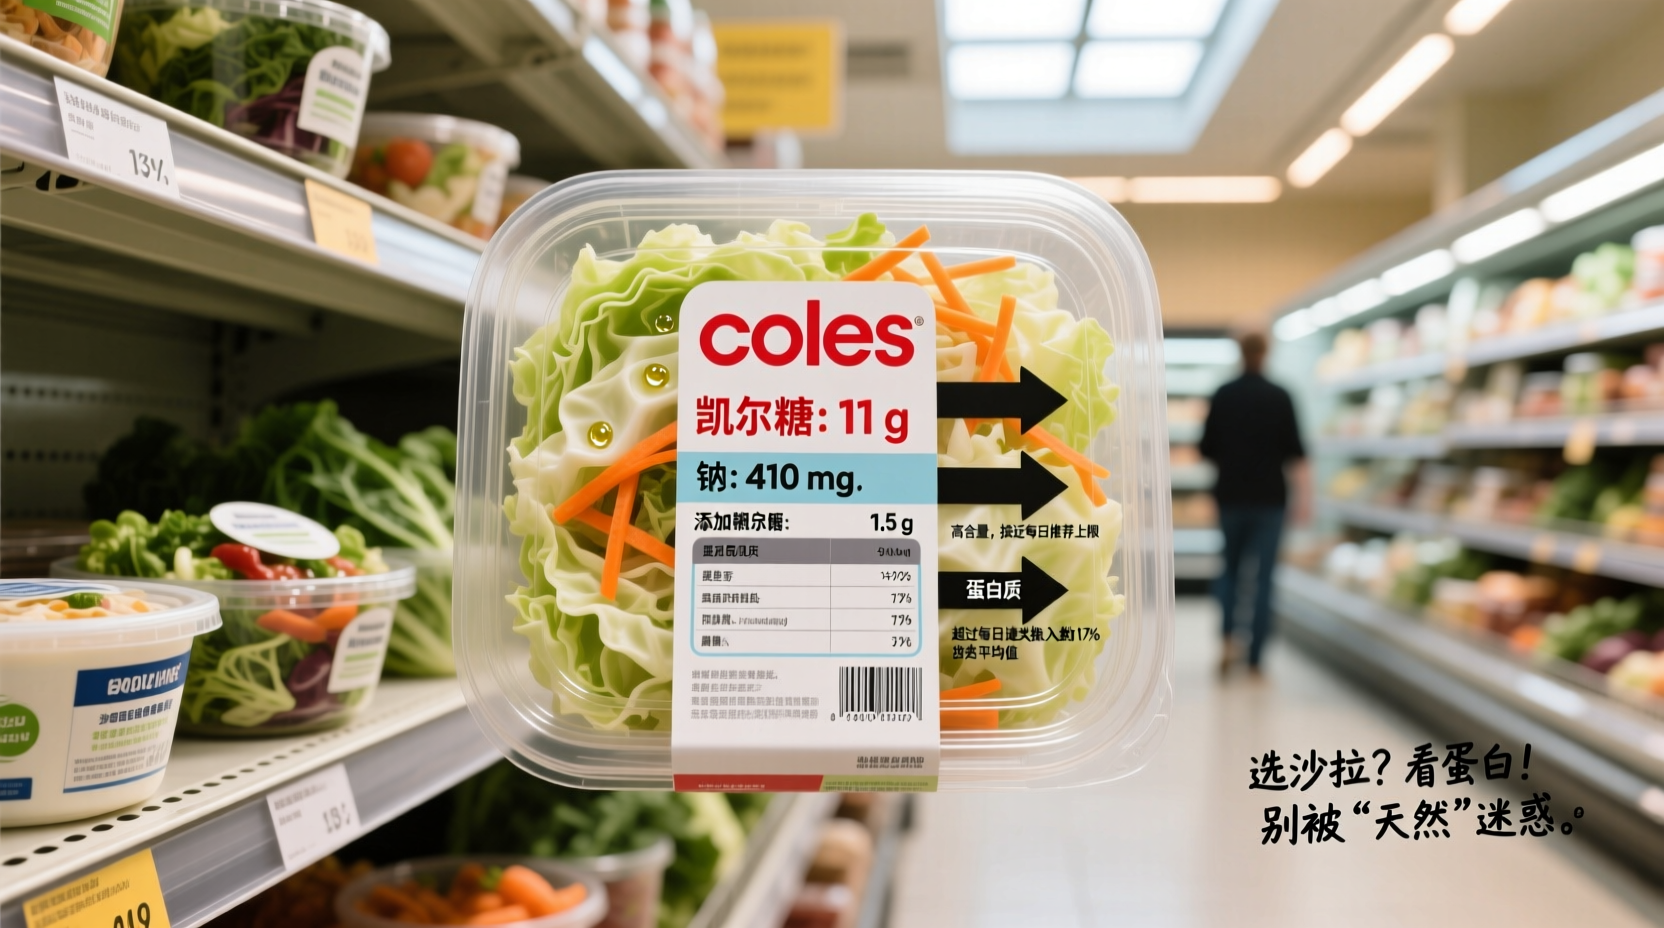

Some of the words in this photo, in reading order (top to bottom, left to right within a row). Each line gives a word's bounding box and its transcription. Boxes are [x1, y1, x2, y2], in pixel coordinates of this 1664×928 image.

[696, 395, 827, 437] 凯尔糖:
[839, 399, 872, 435] 11
[884, 408, 909, 444] g
[745, 462, 800, 491] 410
[807, 470, 863, 498] mg.
[870, 513, 897, 532] 1.5
[901, 517, 914, 536] g
